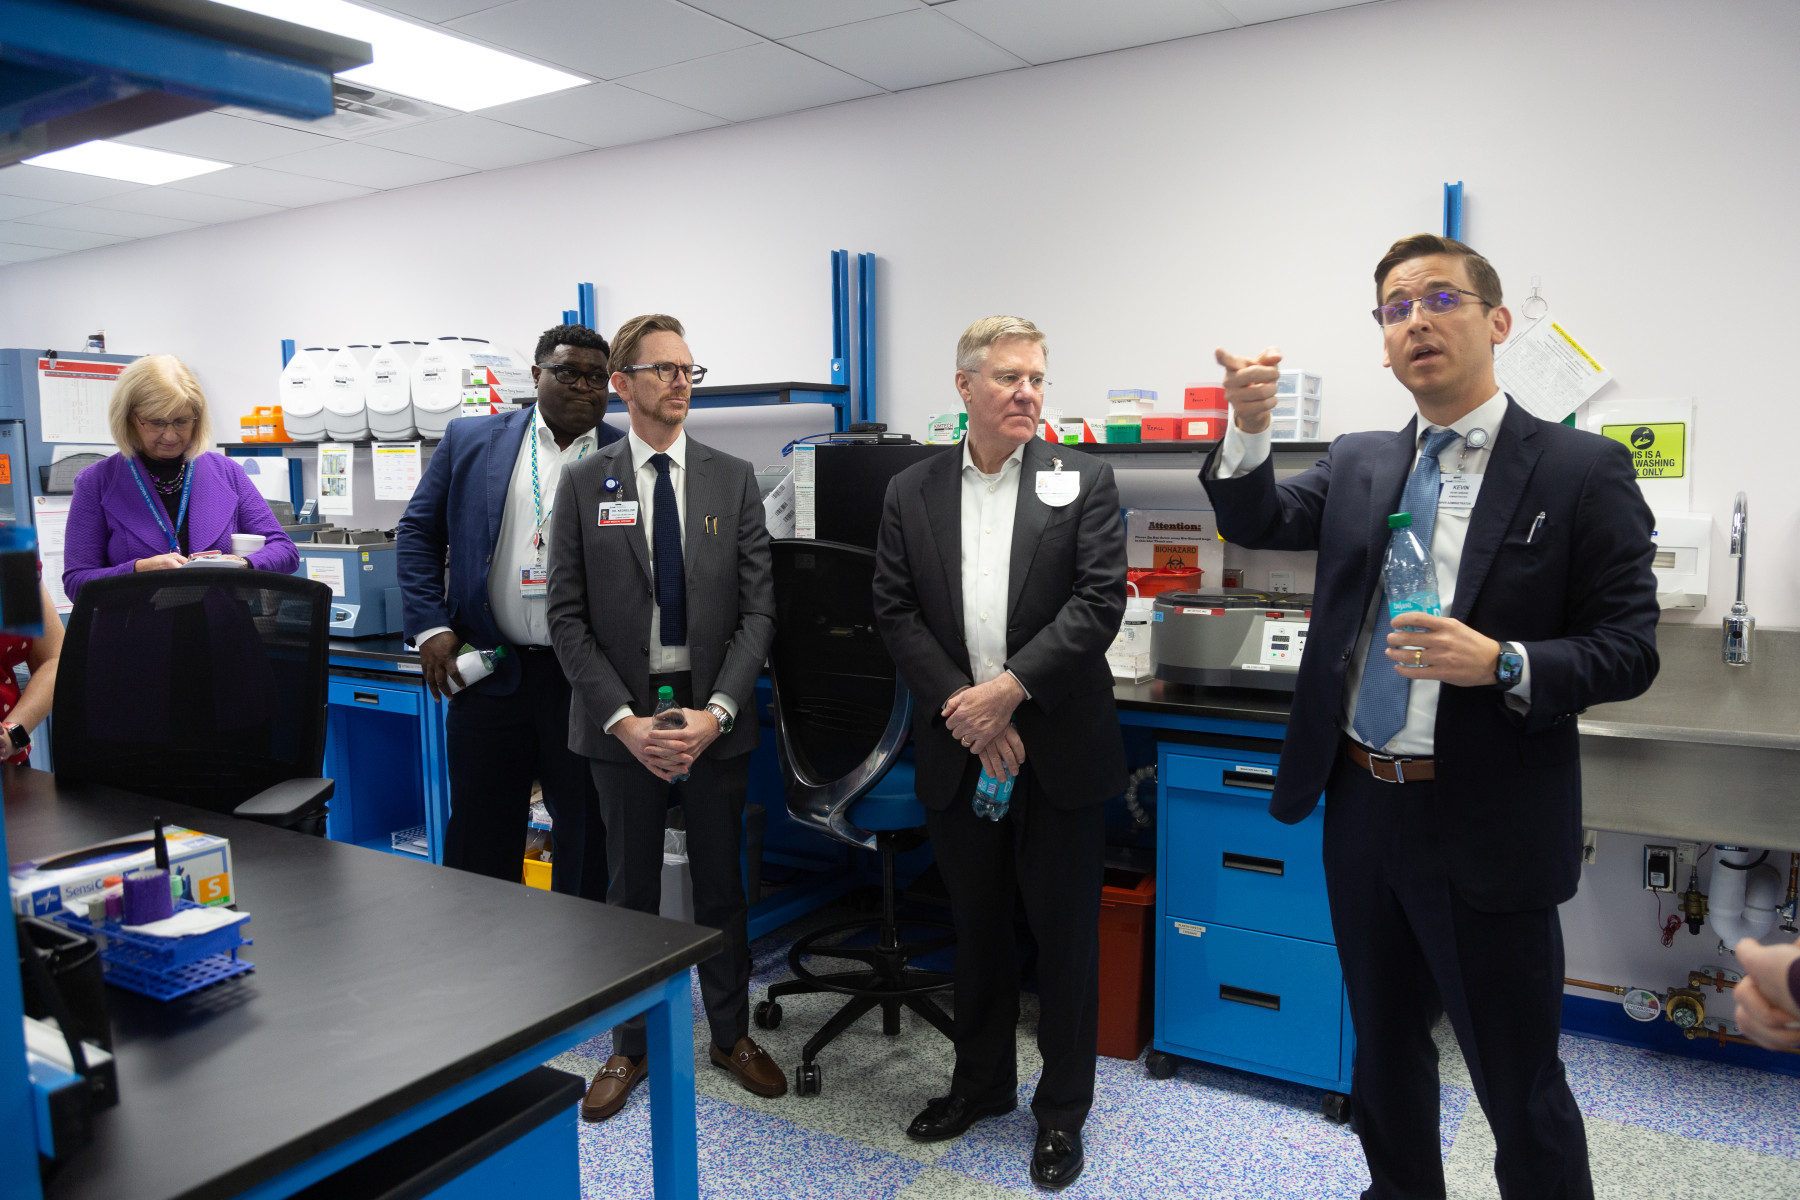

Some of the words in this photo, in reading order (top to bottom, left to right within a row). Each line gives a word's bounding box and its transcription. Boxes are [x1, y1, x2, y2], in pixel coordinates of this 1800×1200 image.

[1635, 459, 1675, 467] WASHING
[1642, 468, 1664, 476] ONLY
[1148, 521, 1202, 531] Attention:
[1155, 546, 1197, 554] BIOHAZARD
[65, 877, 104, 898] SensiC
[208, 878, 221, 897] S
